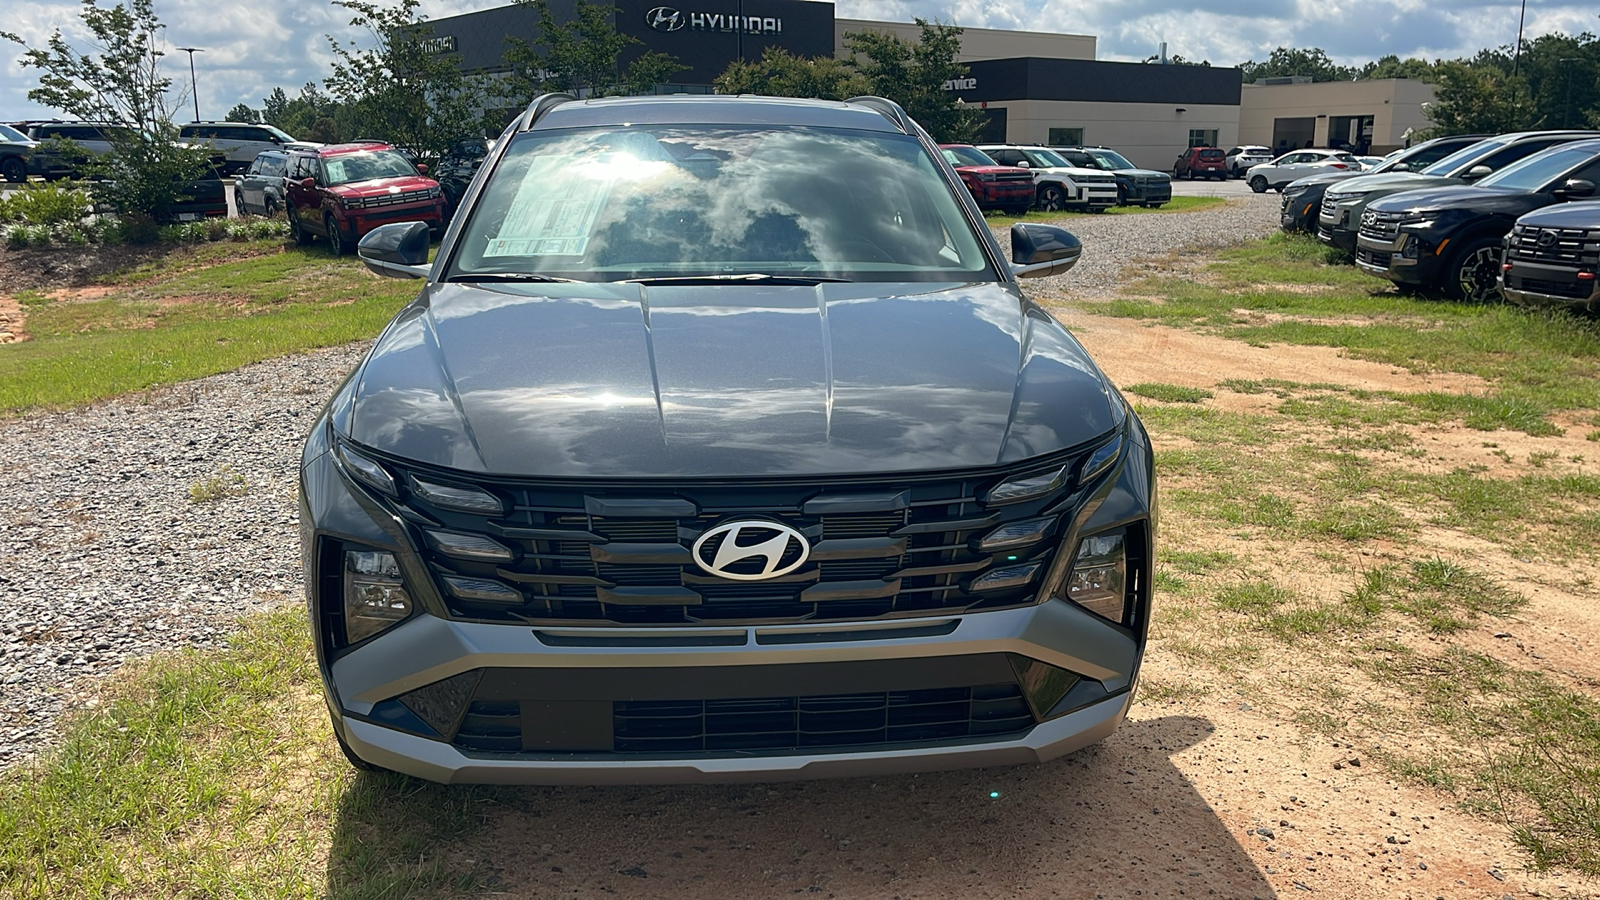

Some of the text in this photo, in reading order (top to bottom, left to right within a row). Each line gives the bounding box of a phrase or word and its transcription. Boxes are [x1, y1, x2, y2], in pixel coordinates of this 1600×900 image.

[690, 12, 782, 32] HYUNDAI
[418, 36, 452, 54] YUNDAI
[942, 75, 977, 91] ervice
